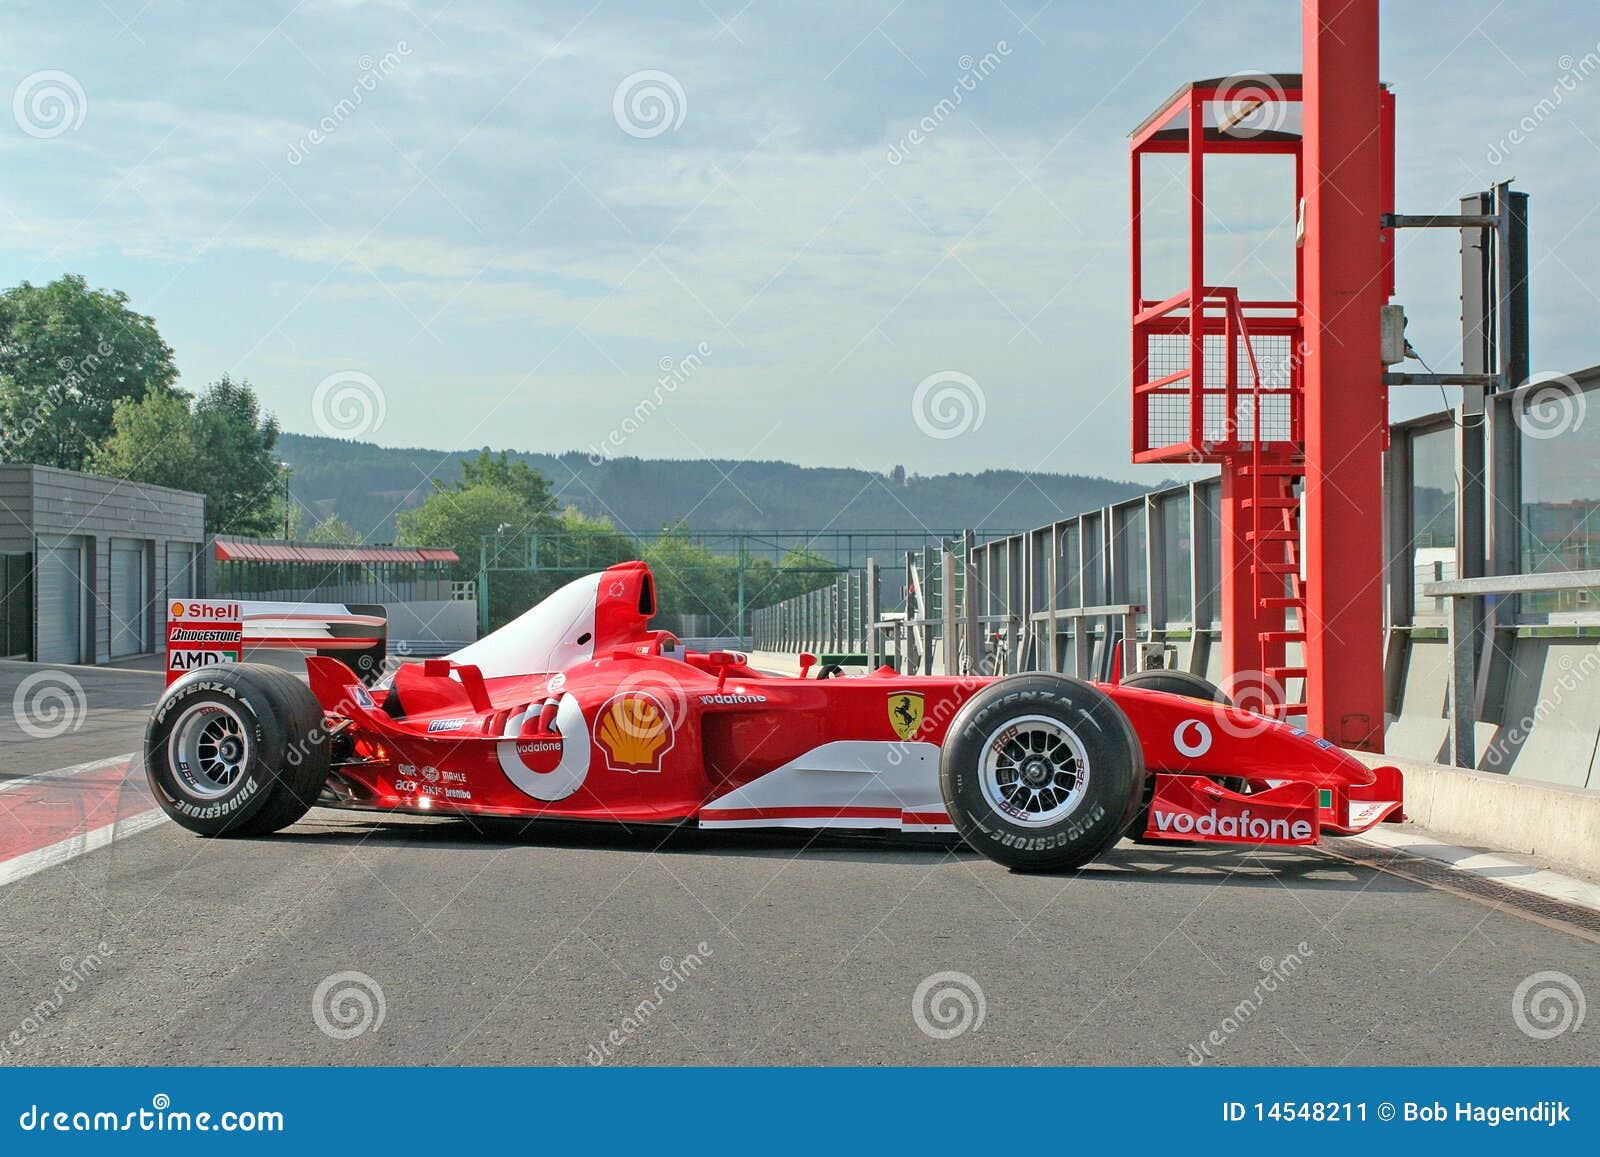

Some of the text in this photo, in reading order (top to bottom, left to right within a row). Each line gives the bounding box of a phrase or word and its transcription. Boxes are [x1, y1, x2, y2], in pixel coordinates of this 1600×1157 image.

[188, 603, 239, 618] Shell
[170, 628, 241, 642] BRIDGESTONE
[170, 651, 219, 669] AMD
[157, 682, 236, 724] POTENZA
[700, 693, 767, 706] vodafone
[516, 741, 561, 754] vodafone
[444, 787, 472, 800] brembo
[1152, 808, 1313, 841] vodafone
